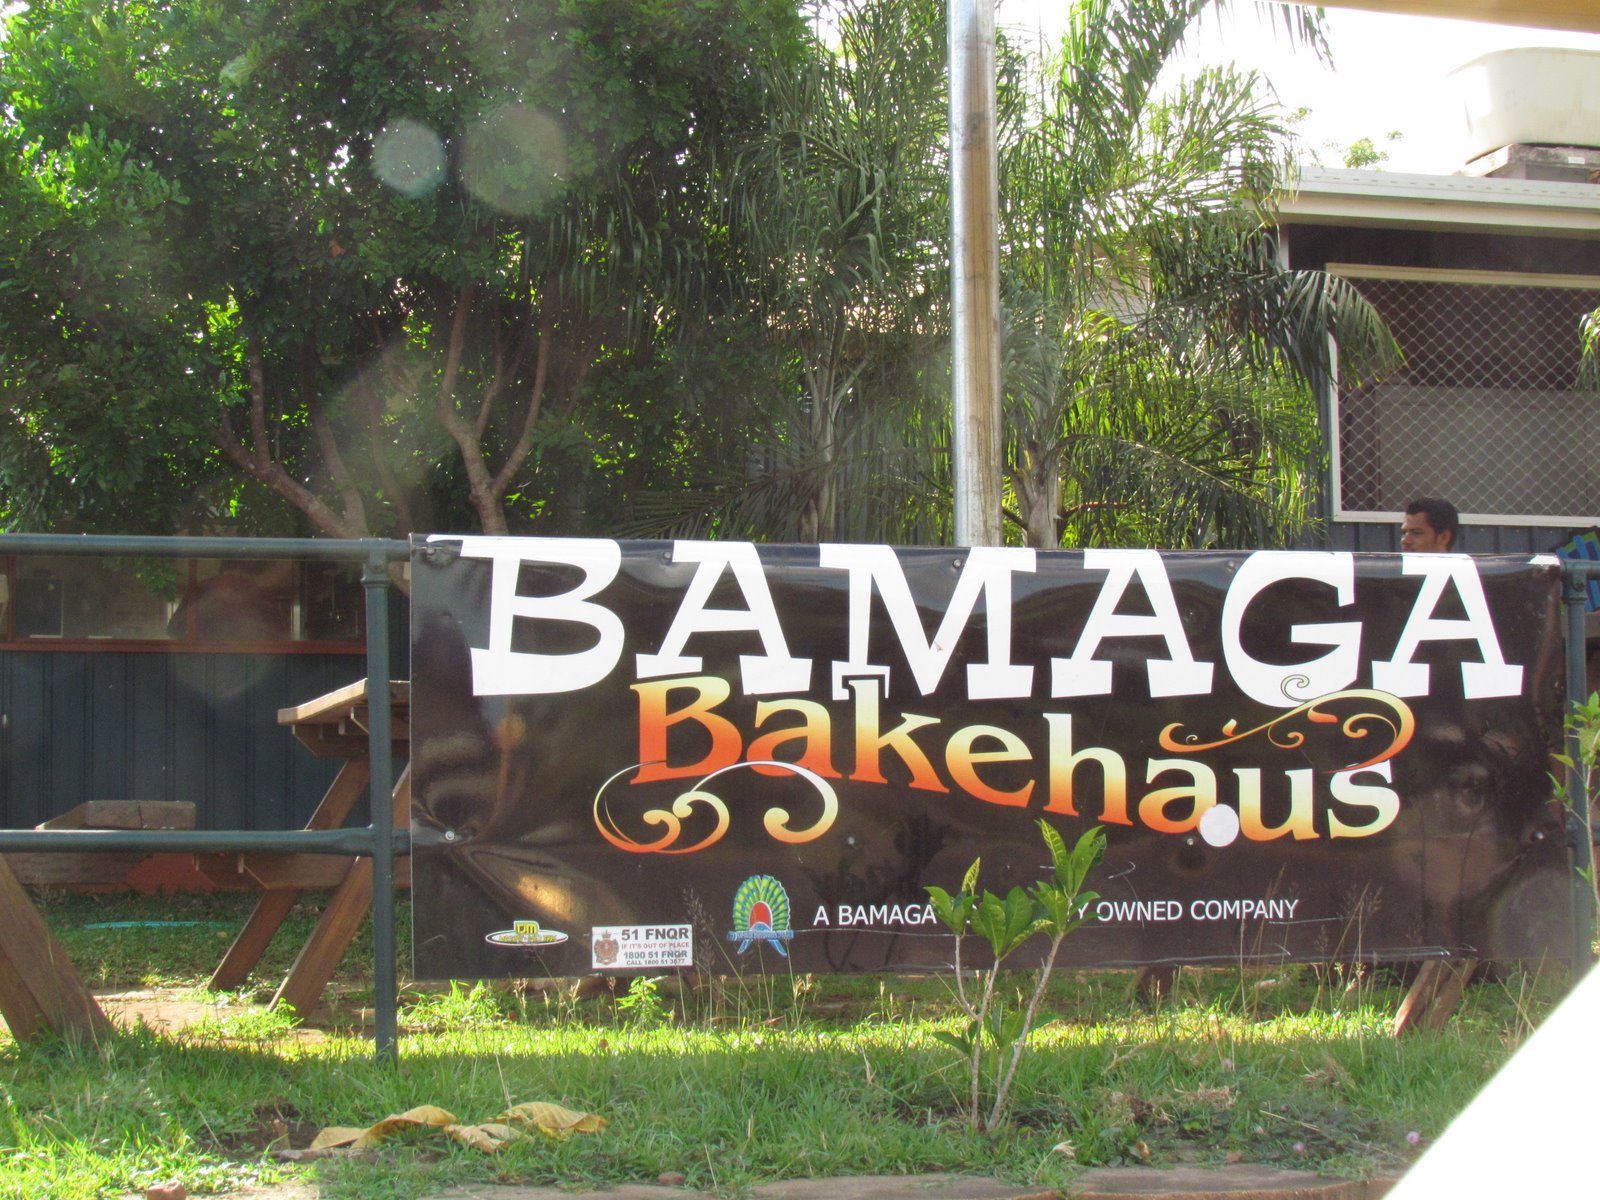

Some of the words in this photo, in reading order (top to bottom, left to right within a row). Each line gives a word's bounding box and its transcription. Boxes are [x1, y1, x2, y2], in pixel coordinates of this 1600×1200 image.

[460, 536, 1524, 707] BAMAGA
[630, 677, 1400, 842] Bakehaus
[813, 907, 829, 926] A
[838, 904, 936, 925] BAMAGA
[1097, 901, 1183, 922] OWNED
[1190, 899, 1299, 921] COMPANY
[621, 928, 639, 941] 51
[645, 927, 689, 940] FNQR
[624, 951, 645, 959] 1800
[661, 950, 688, 958] FNQR
